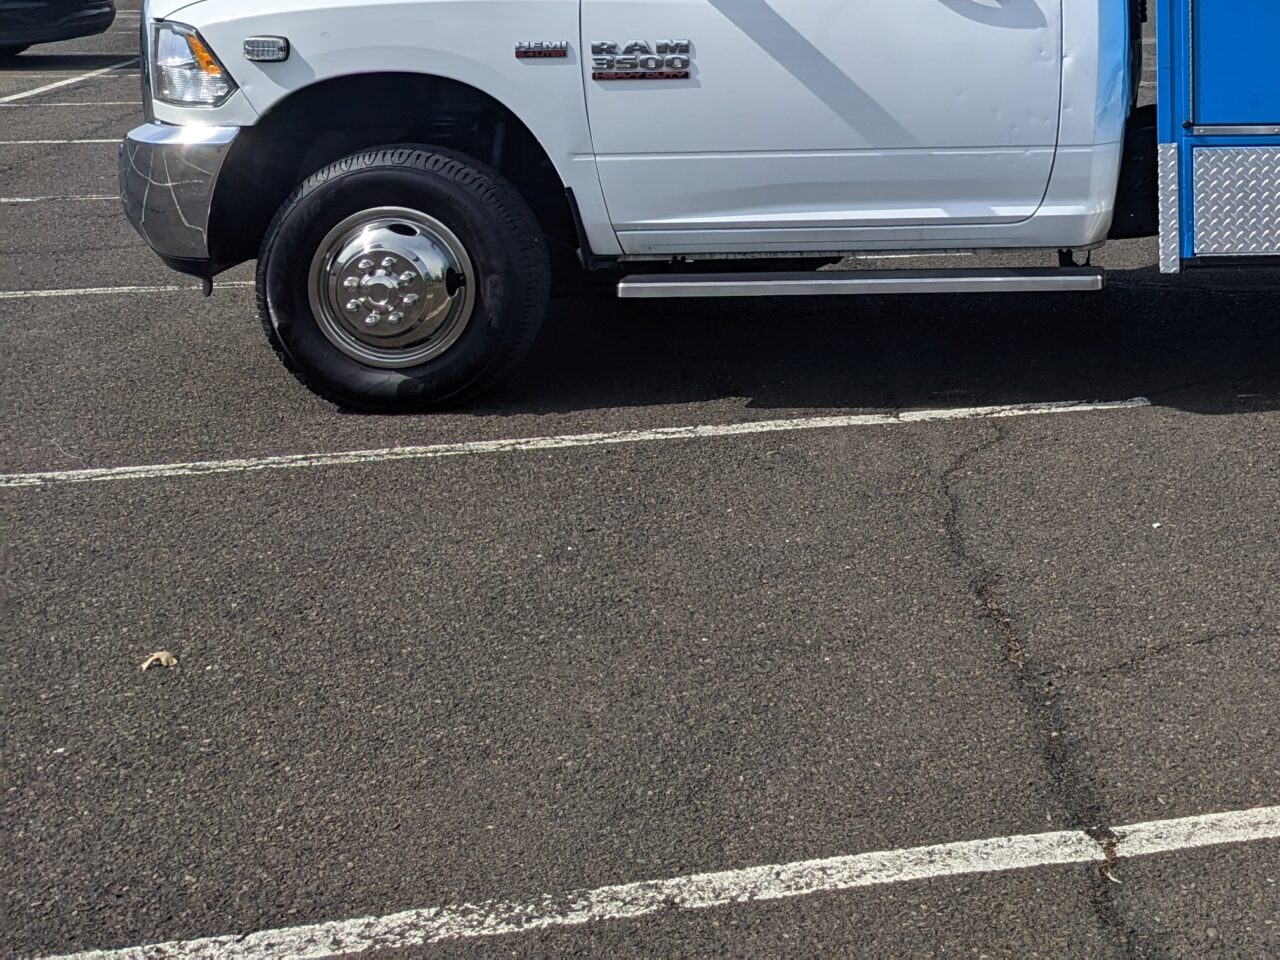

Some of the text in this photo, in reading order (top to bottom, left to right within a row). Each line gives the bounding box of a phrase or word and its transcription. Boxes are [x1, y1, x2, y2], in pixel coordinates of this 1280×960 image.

[514, 40, 567, 50] HEMI
[591, 40, 690, 54] RAM
[592, 55, 690, 70] 3500
[595, 71, 686, 80] HEAVY DUTY
